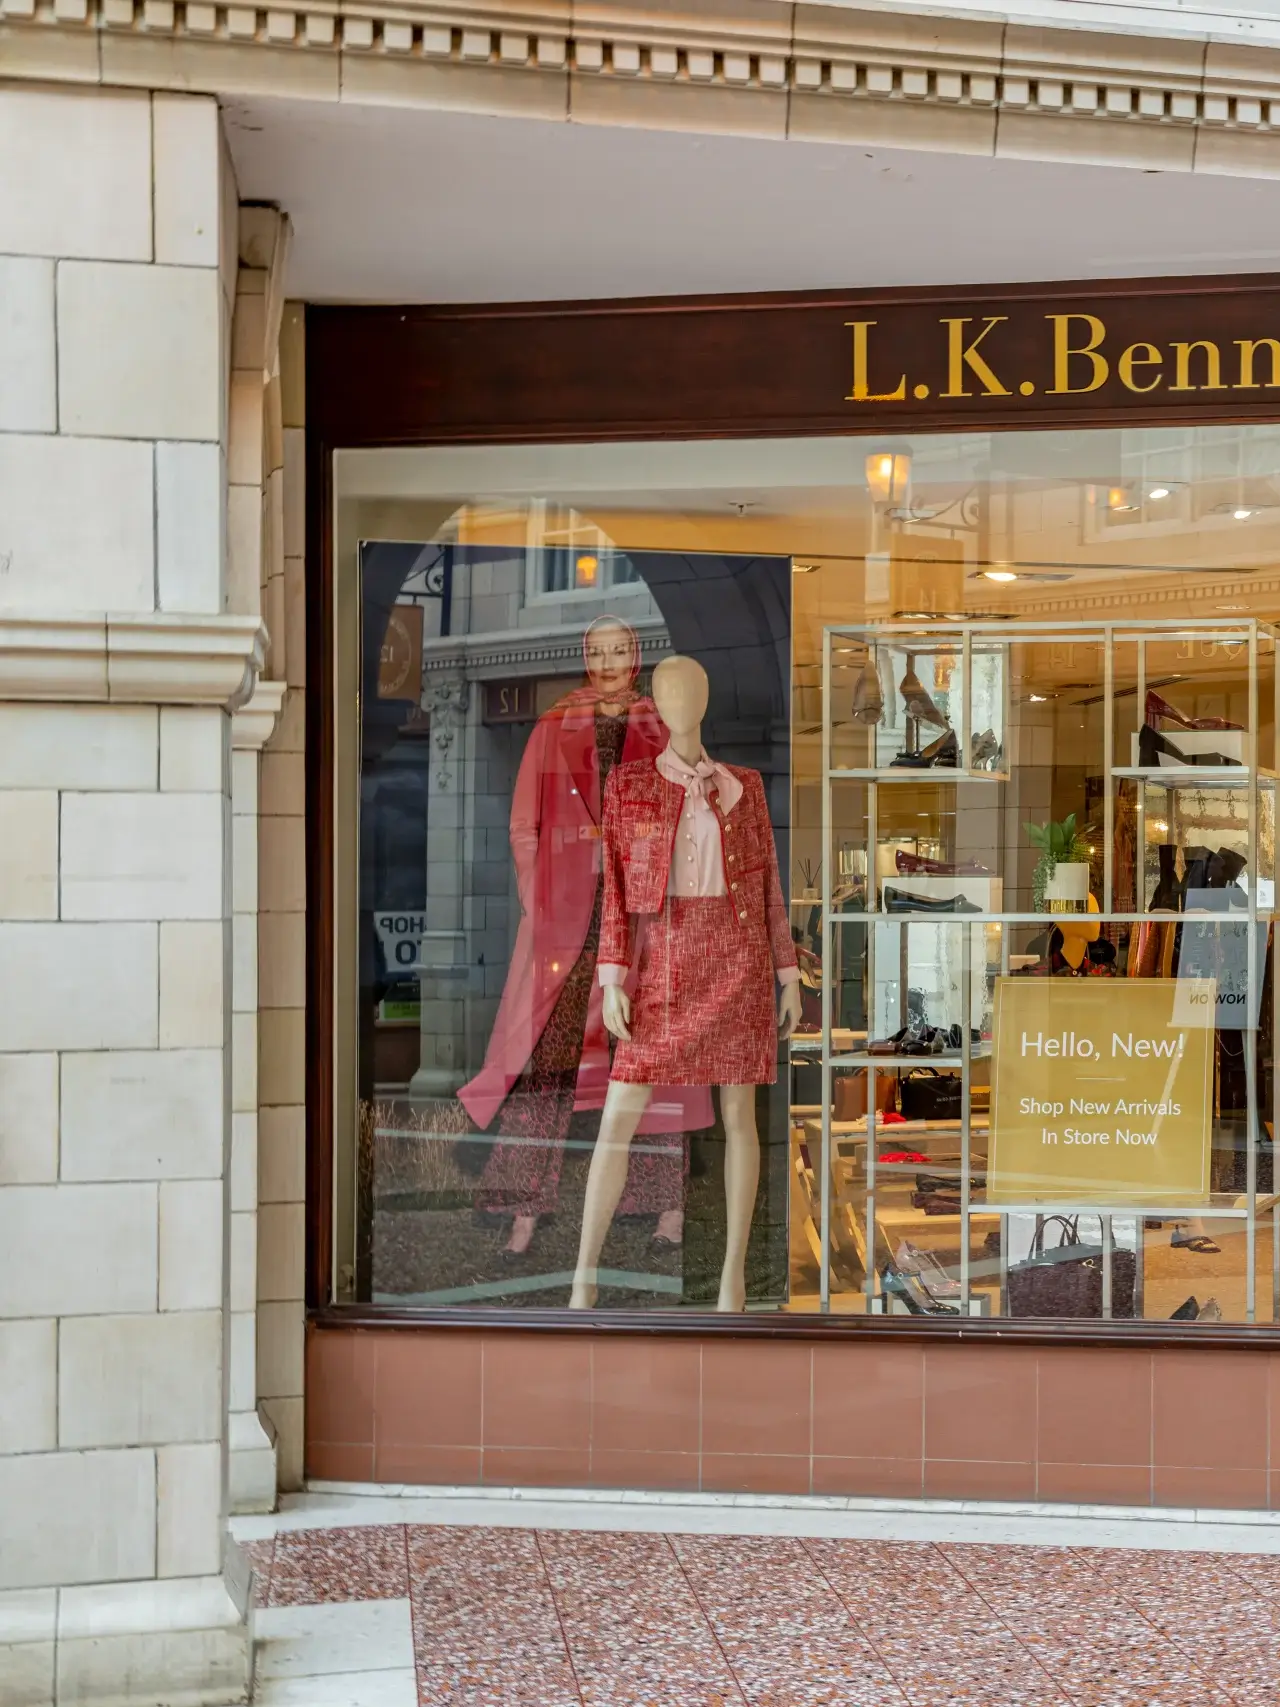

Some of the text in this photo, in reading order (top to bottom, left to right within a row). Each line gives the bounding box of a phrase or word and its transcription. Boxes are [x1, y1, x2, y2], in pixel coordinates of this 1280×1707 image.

[1021, 1031, 1184, 1061] Hello, New!
[1019, 1097, 1182, 1118] Shop New Arrivals
[1042, 1128, 1158, 1145] In Store Now
